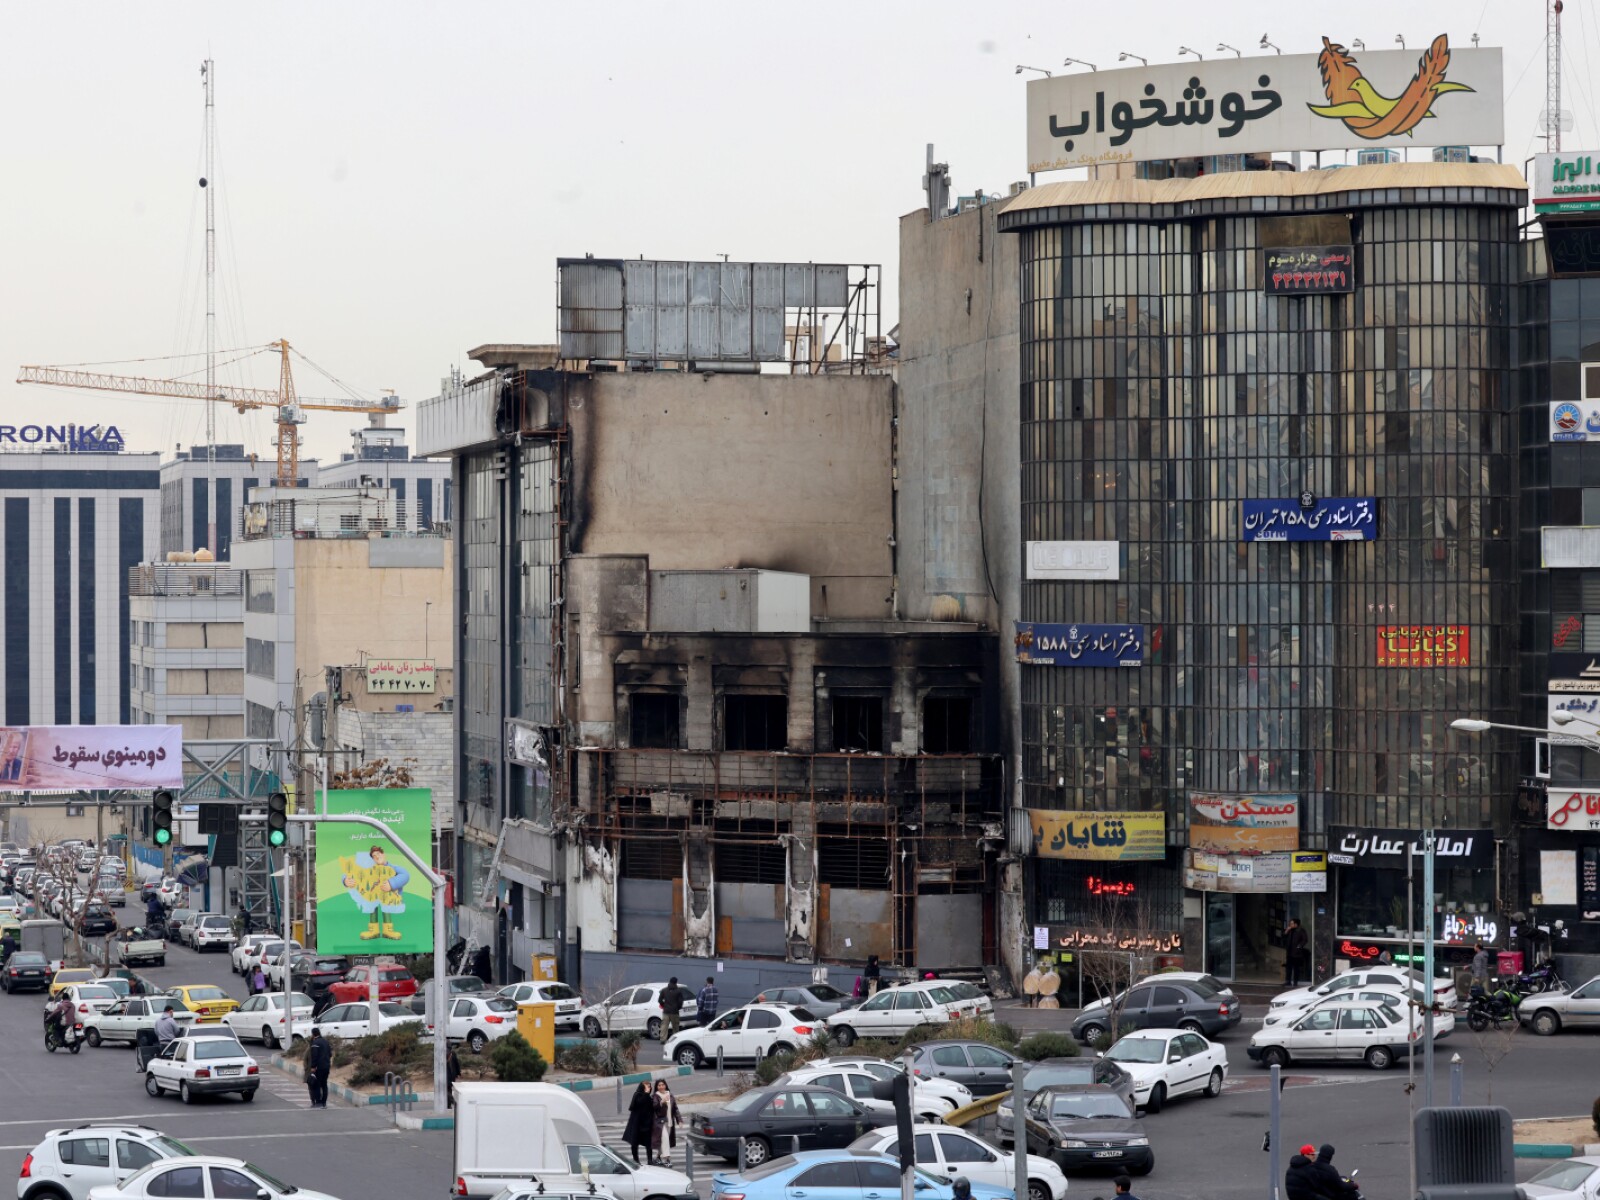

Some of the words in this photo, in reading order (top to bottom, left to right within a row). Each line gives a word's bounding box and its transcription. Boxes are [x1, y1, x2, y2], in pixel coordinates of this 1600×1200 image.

[1049, 74, 1283, 152] خوشخواب
[1245, 508, 1279, 531] تهران
[1280, 511, 1306, 525] ۲۵۸
[1352, 501, 1373, 527] دفتر
[1037, 637, 1068, 651] ۱۵۸۸
[1114, 628, 1140, 658] دفتر
[415, 662, 434, 674] مطب
[52, 745, 100, 770] سقوط
[101, 746, 166, 772] دومینوی
[1221, 799, 1295, 820] مسکن
[1051, 821, 1127, 851] شایان
[1340, 833, 1405, 856] عمارت
[1474, 916, 1497, 944] ویلا
[1162, 933, 1181, 952] نان
